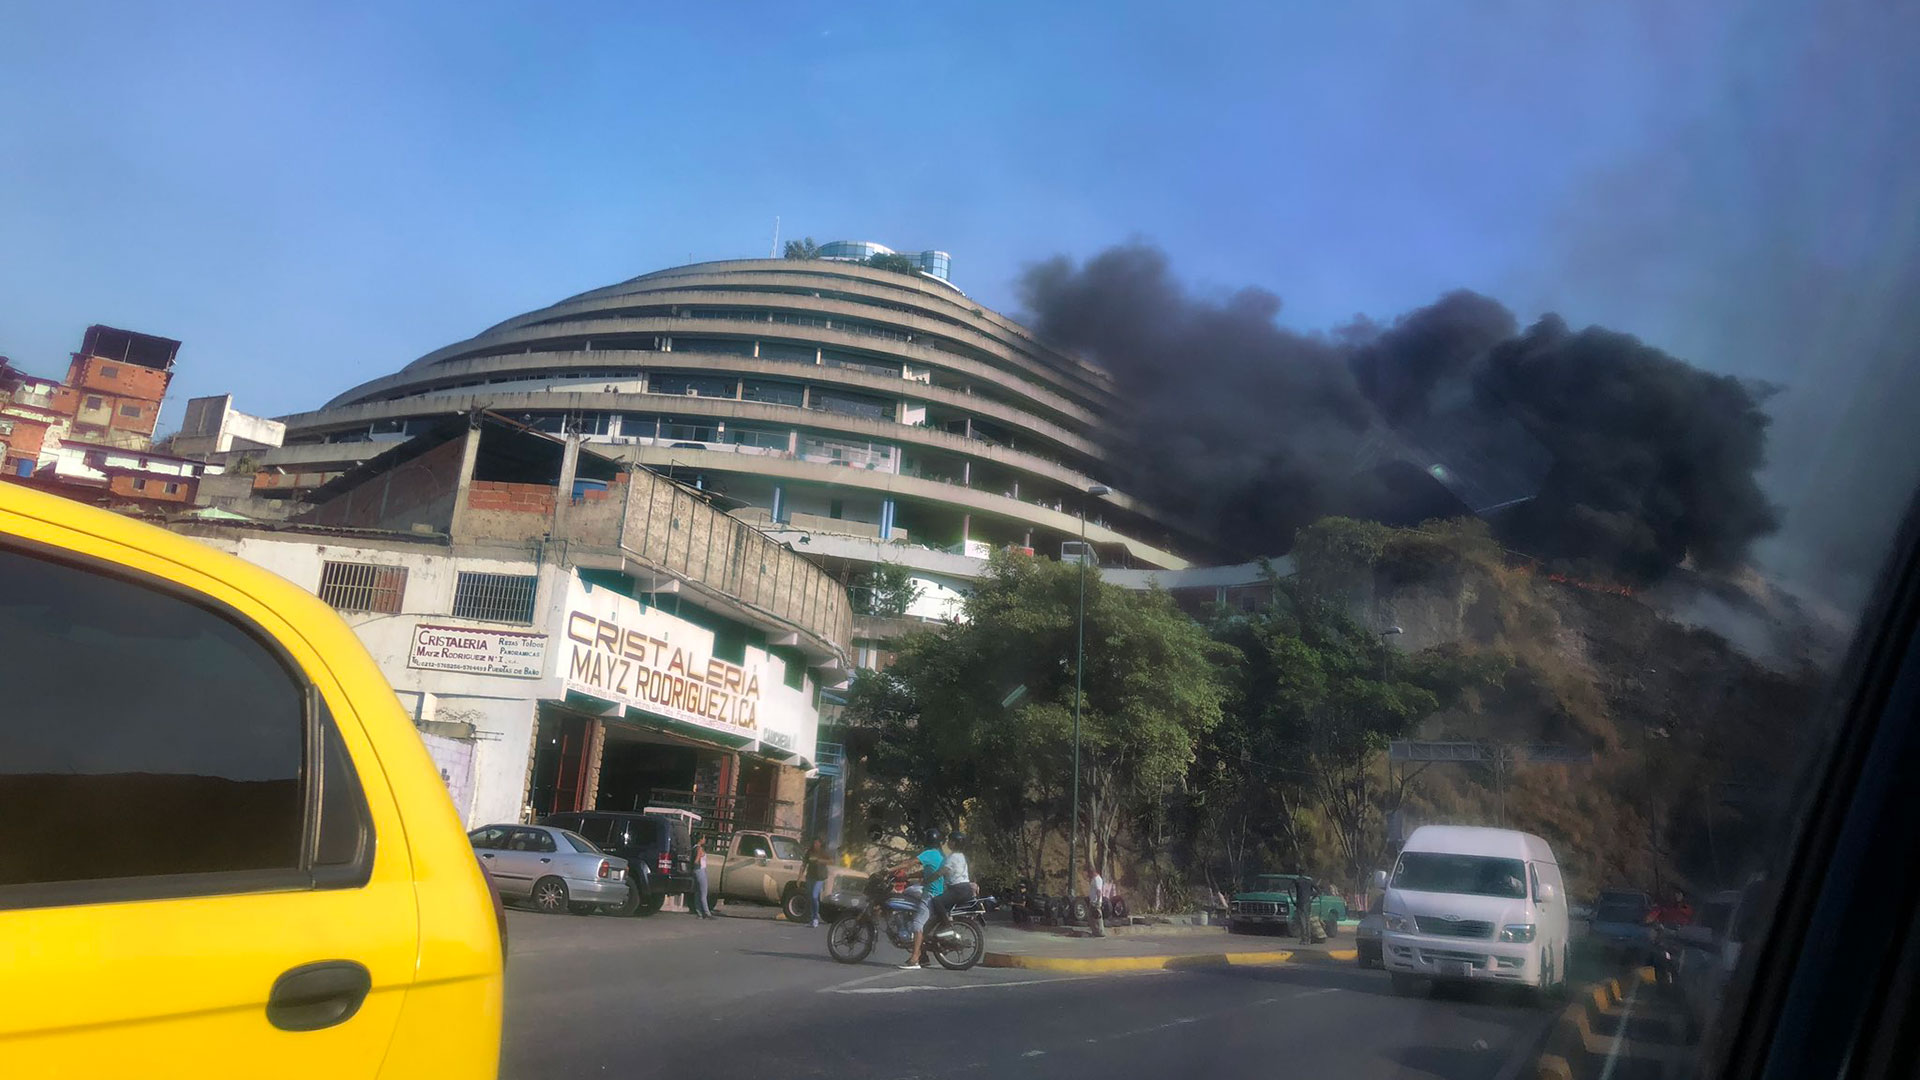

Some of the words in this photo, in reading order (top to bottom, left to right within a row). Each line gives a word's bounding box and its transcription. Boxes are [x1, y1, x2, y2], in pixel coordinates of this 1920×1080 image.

[419, 630, 487, 650] CRISTALERIA
[416, 646, 440, 658] MAYZ
[441, 647, 486, 661] RODRIGUEZ
[567, 610, 760, 700] CRISTALERIA
[487, 664, 512, 674] PUERTAS
[570, 645, 631, 694] MAYZ
[635, 665, 728, 721] RODRIGUEZ
